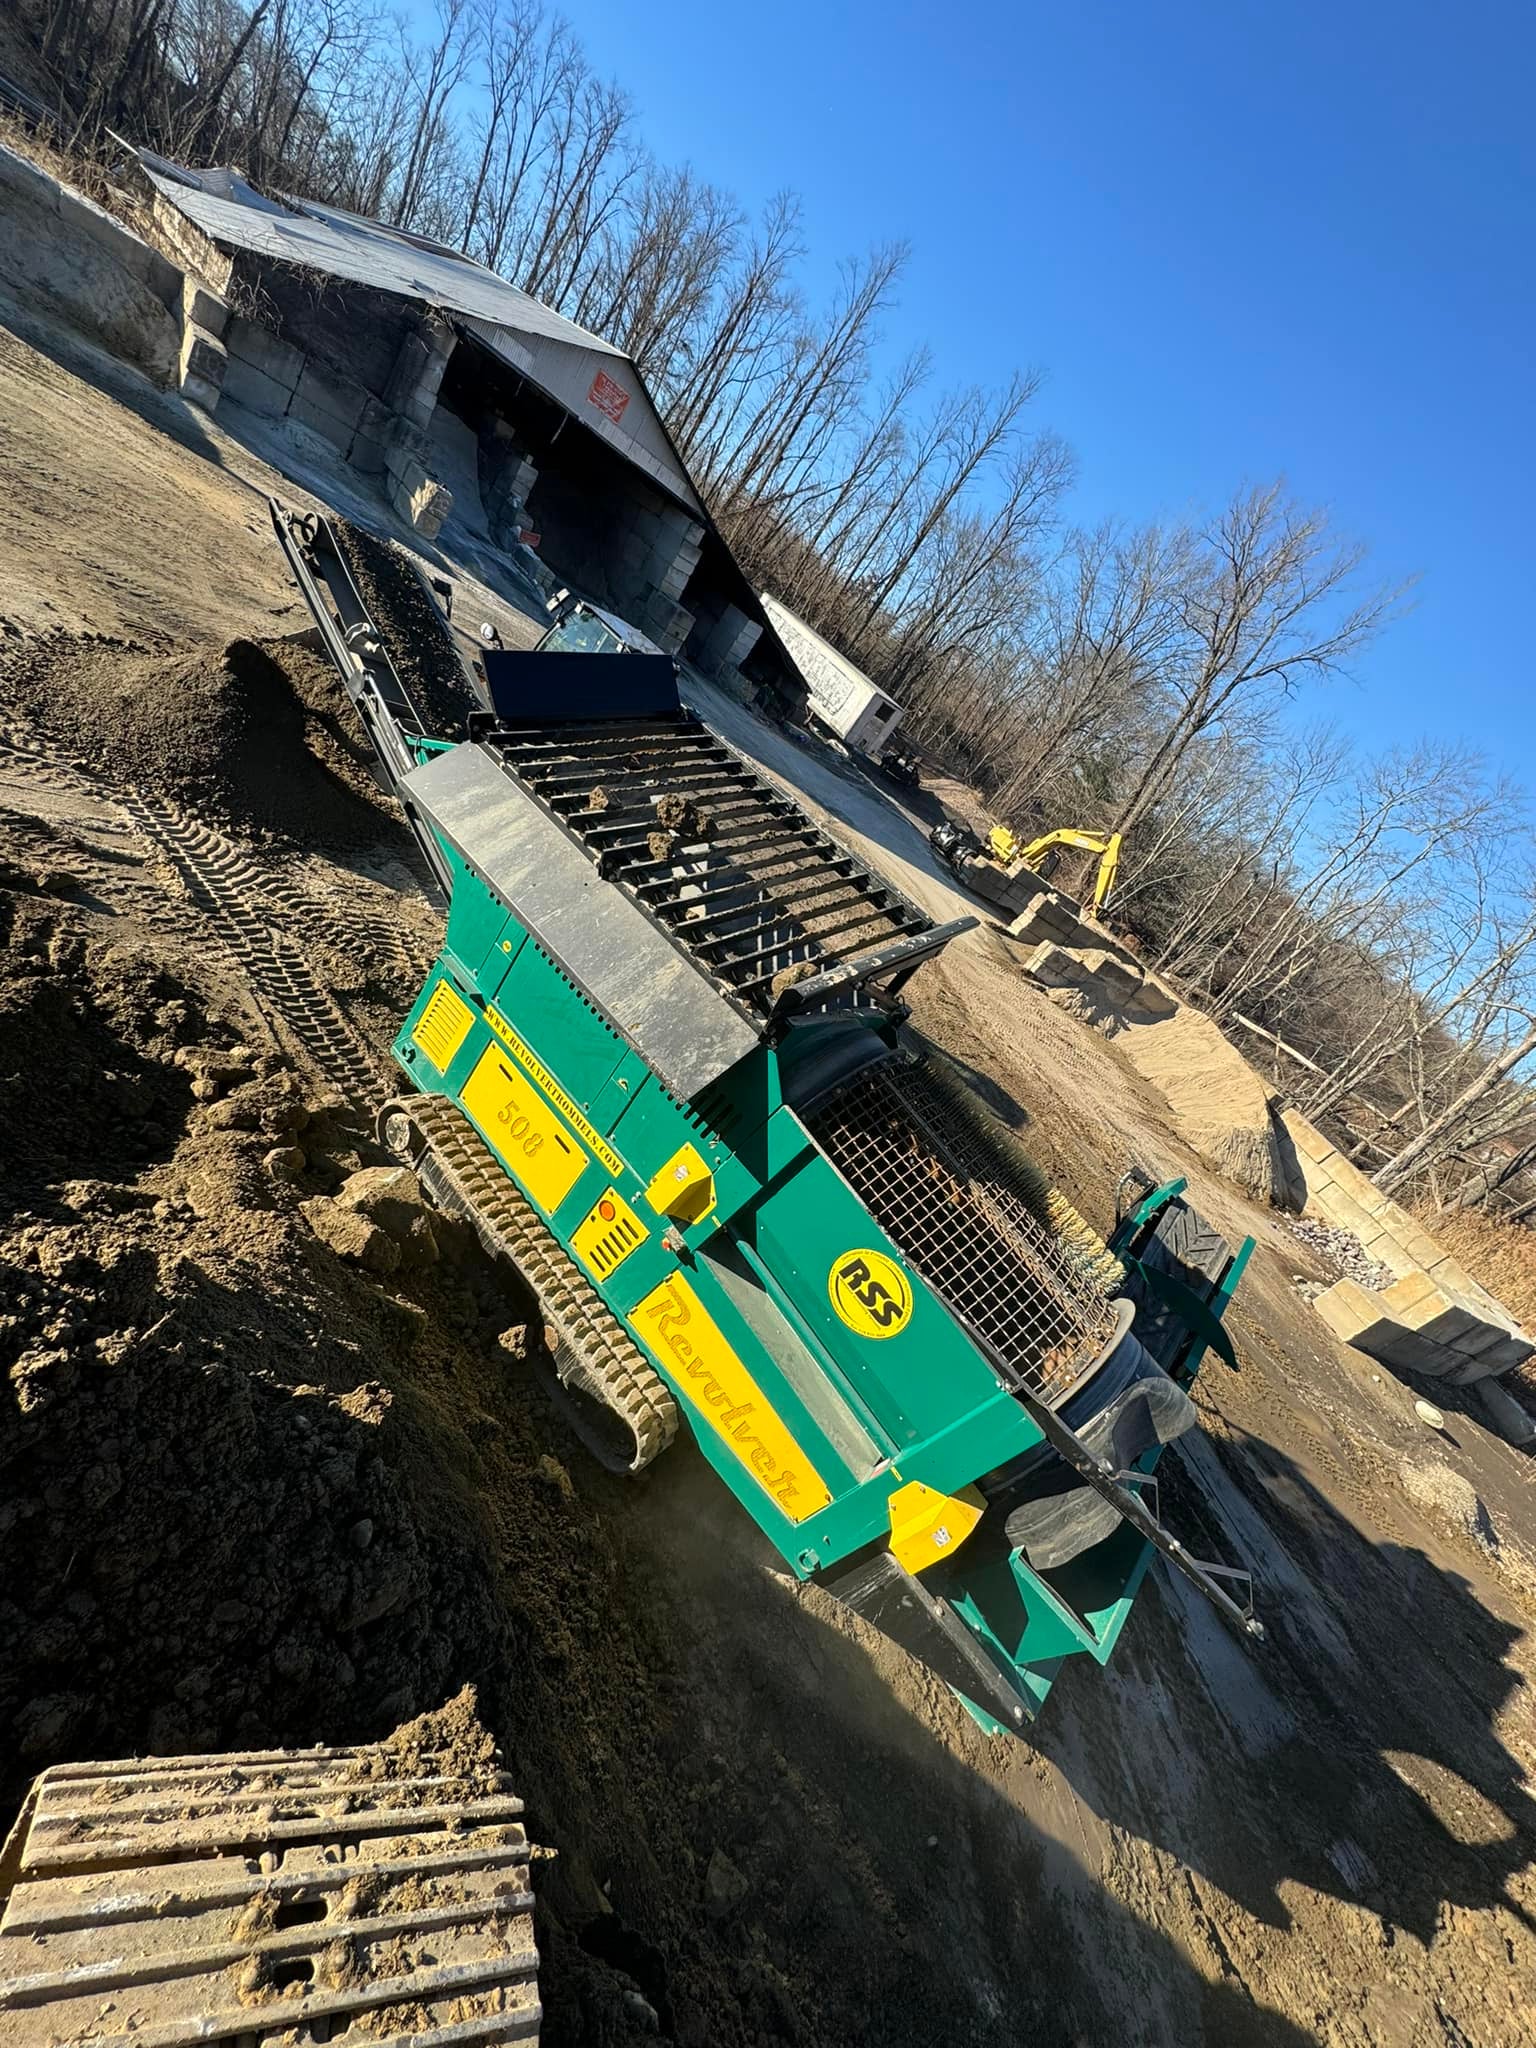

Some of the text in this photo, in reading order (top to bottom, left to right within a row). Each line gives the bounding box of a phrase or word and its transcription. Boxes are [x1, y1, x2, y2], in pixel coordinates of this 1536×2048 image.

[487, 1008, 620, 1173] WWW.REVOLVERTROMMELS.COM
[497, 1099, 545, 1158] 508
[838, 1257, 905, 1327] RSS
[645, 1284, 800, 1509] Revolver
